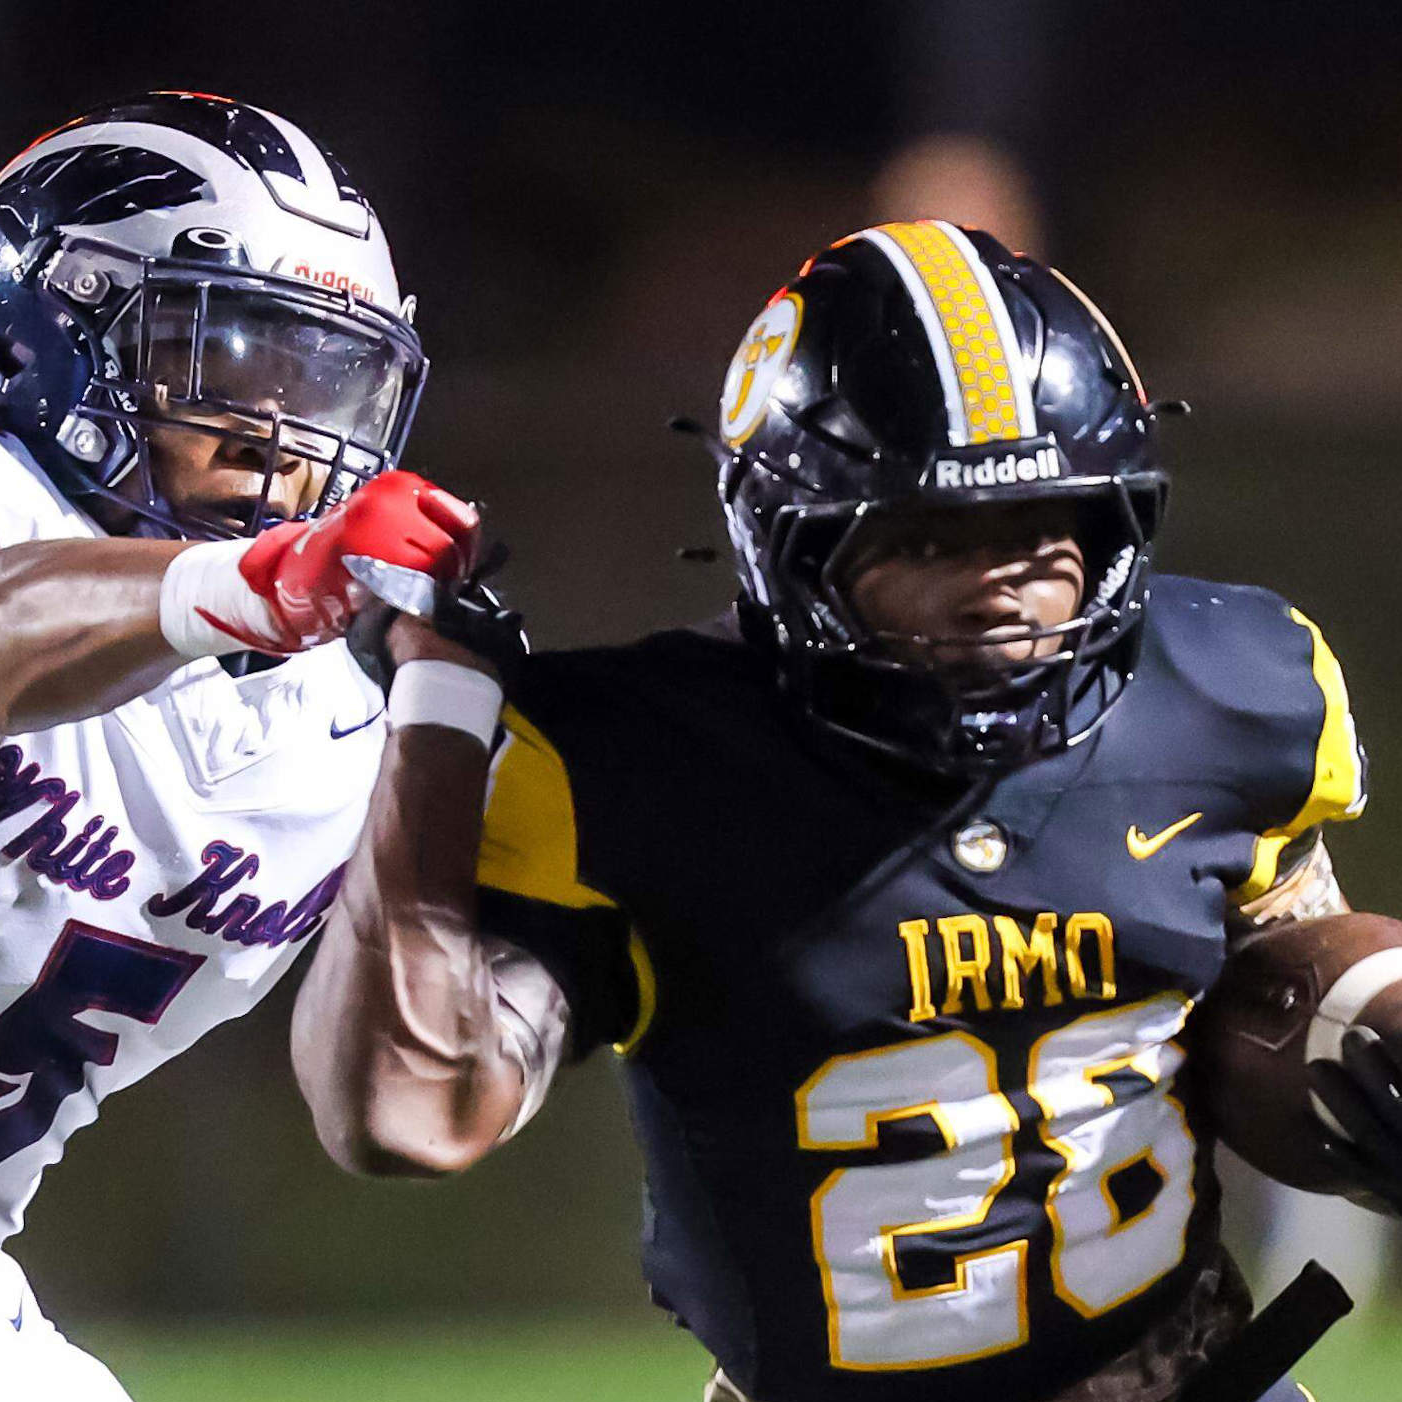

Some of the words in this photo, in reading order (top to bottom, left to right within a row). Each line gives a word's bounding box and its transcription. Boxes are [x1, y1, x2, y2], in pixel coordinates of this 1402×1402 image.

[936, 447, 1060, 488] Riddell
[1094, 544, 1135, 607] iddell
[898, 911, 1116, 1023] IRMO
[795, 989, 1199, 1371] 28
